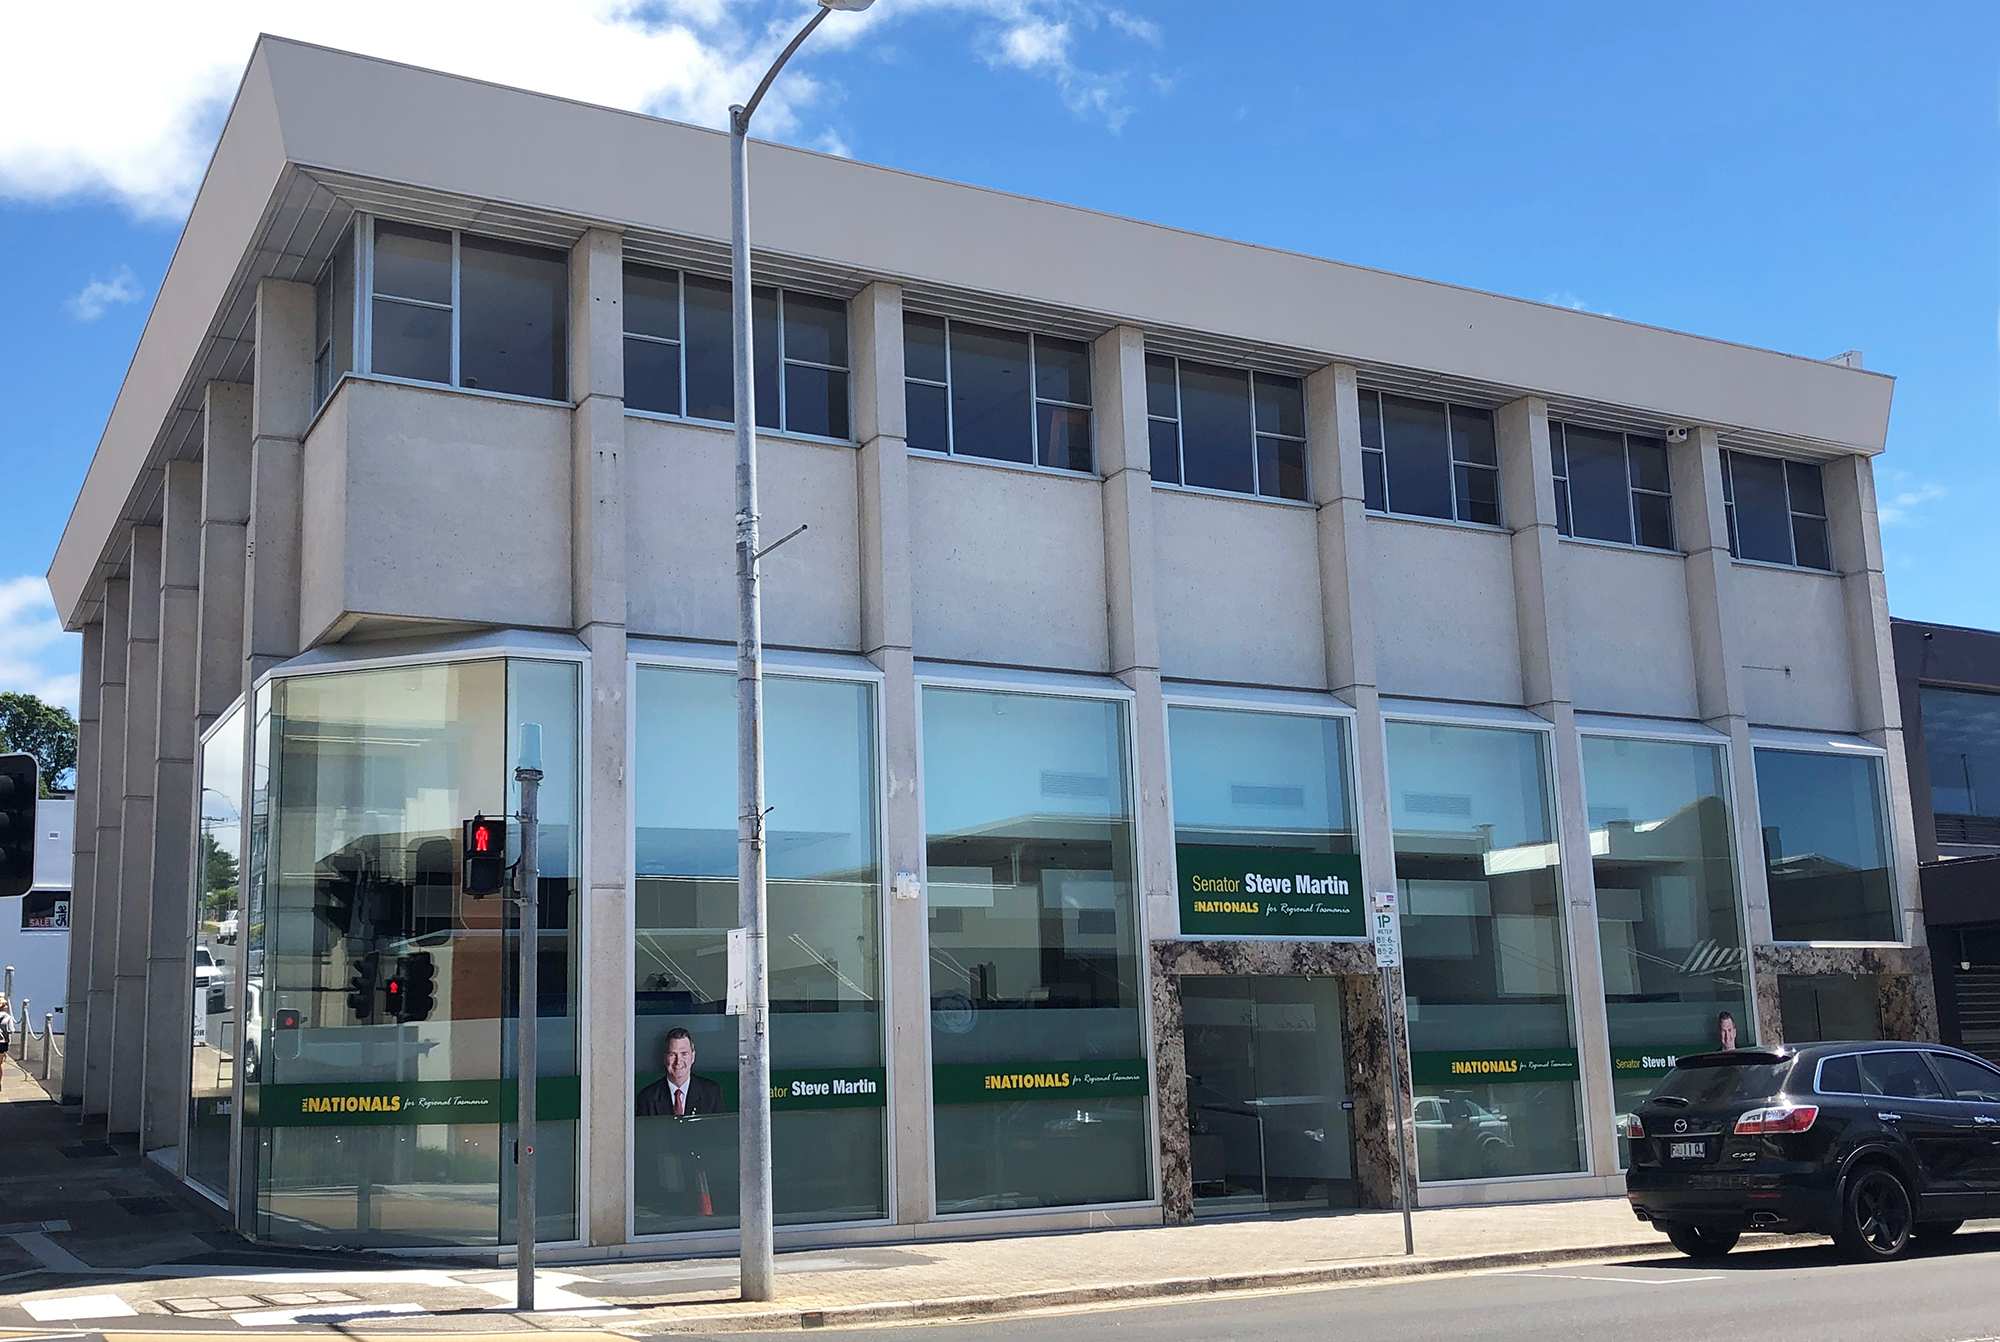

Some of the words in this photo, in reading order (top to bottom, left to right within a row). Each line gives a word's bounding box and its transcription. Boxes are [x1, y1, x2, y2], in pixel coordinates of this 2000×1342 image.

[1192, 875, 1240, 892] Senator
[1245, 873, 1291, 894] Steve
[1295, 874, 1349, 895] Martin
[1199, 901, 1259, 913] NATIONALS
[1266, 903, 1278, 916] for
[1280, 903, 1313, 916] Regional
[1315, 902, 1350, 914] Tasmania
[30, 918, 50, 927] SALE
[1377, 914, 1391, 928] 1P
[1456, 1060, 1517, 1074] NATIONALS
[1616, 1059, 1640, 1069] Senator
[1642, 1056, 1666, 1068] Steve
[990, 1072, 1070, 1089] NATIONALS
[1072, 1074, 1082, 1086] for
[1084, 1073, 1110, 1084] Regional
[768, 1086, 788, 1098] ator
[791, 1080, 829, 1096] Steve
[833, 1079, 877, 1094] Martin
[308, 1096, 400, 1113] NATIONALS
[403, 1098, 415, 1110] for
[418, 1097, 451, 1109] Regional
[453, 1096, 488, 1105] Tasmania
